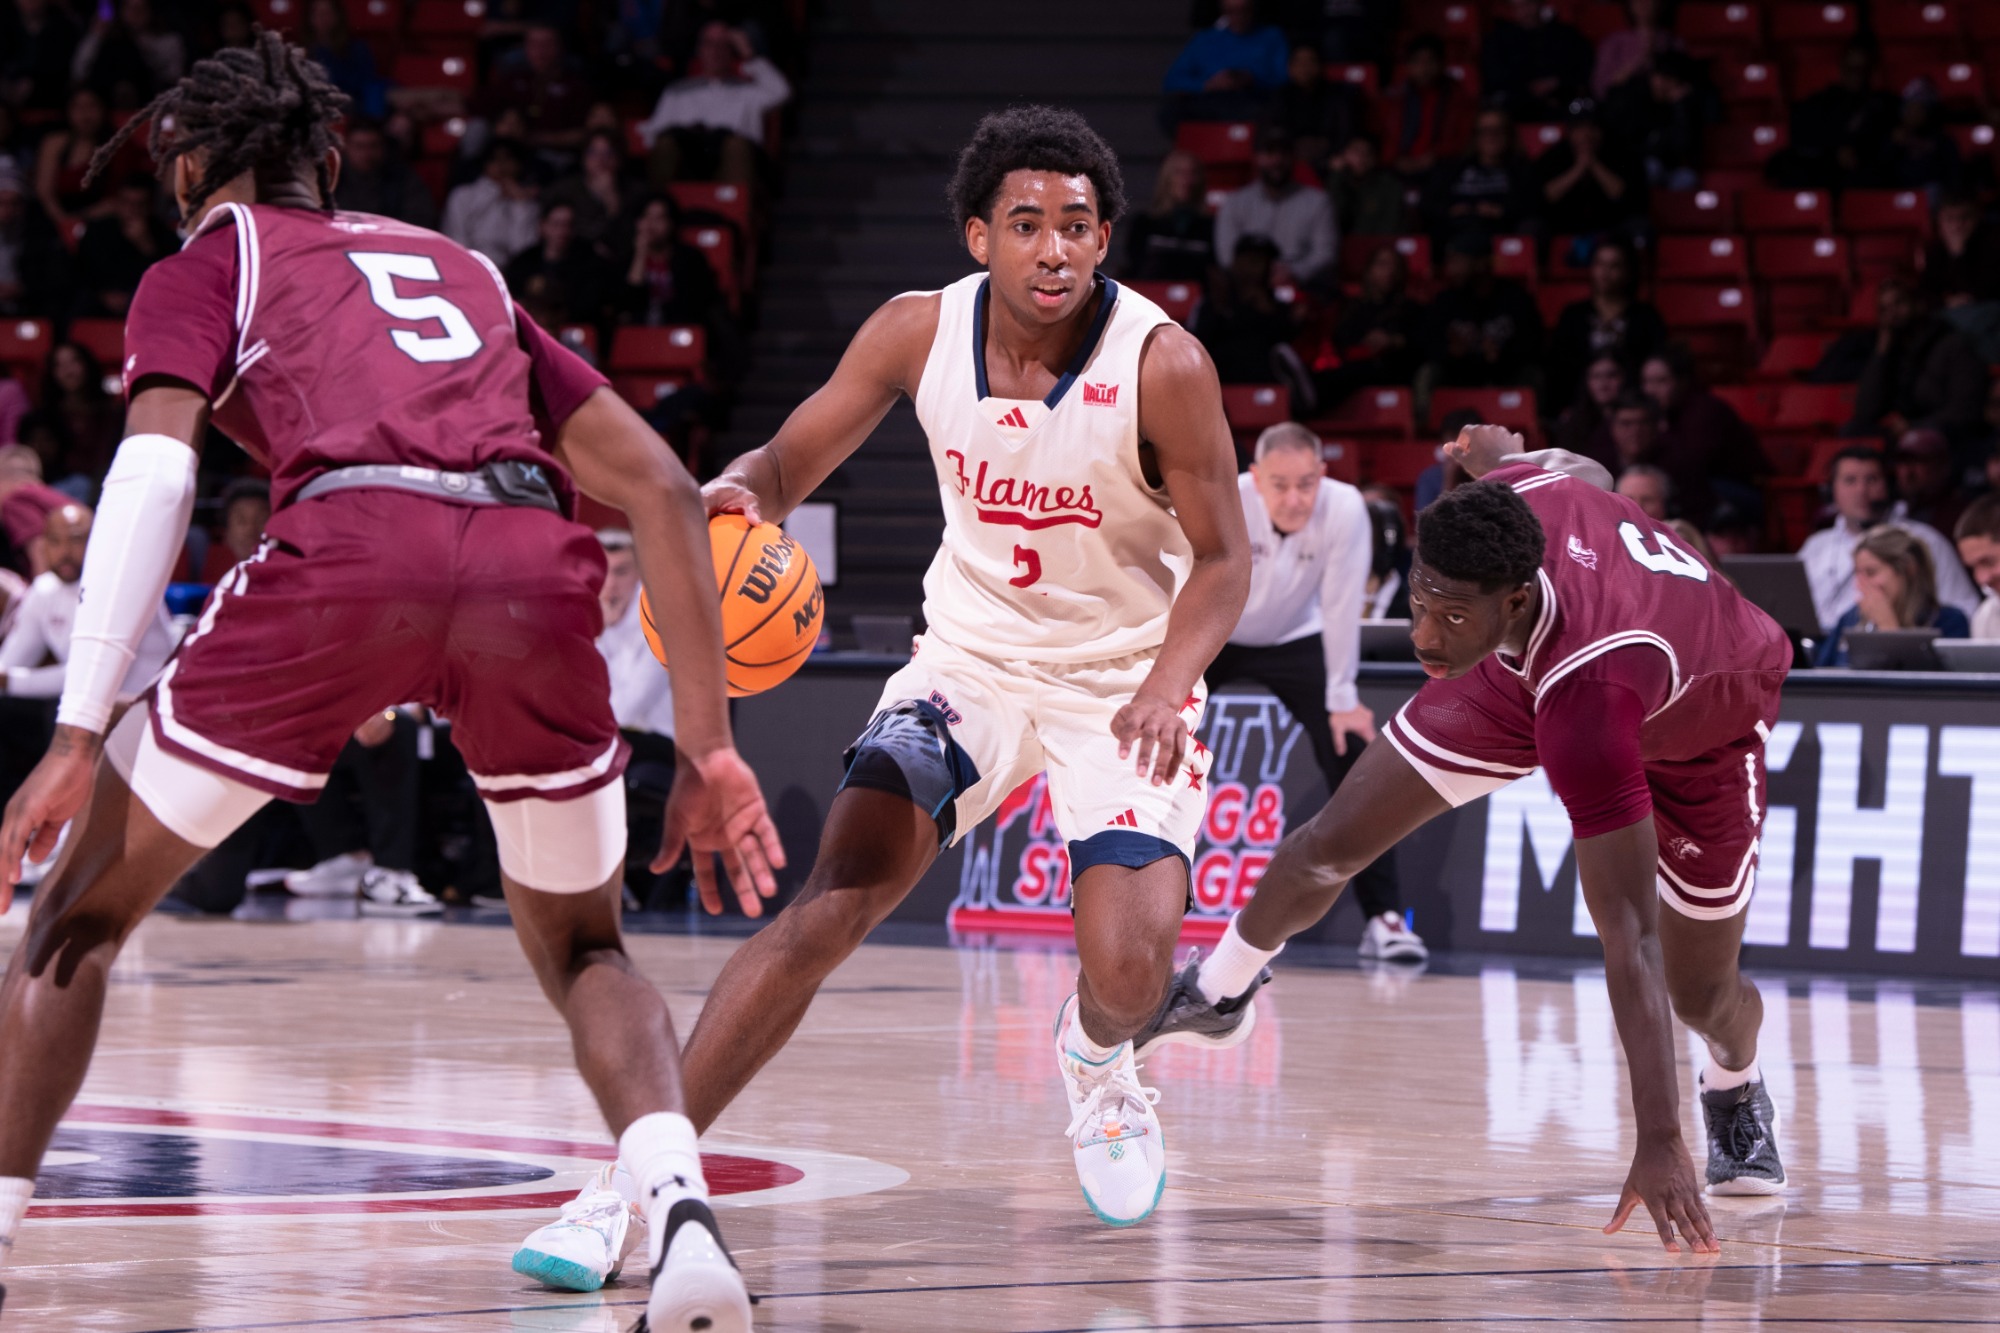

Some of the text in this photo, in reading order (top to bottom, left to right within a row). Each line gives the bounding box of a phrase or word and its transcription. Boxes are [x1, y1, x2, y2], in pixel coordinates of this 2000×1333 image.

[345, 252, 485, 363] 5
[1083, 381, 1120, 405] VALLEY
[946, 449, 1103, 531] Flames
[737, 530, 796, 605] Wilso
[1198, 694, 1304, 782] ITY
